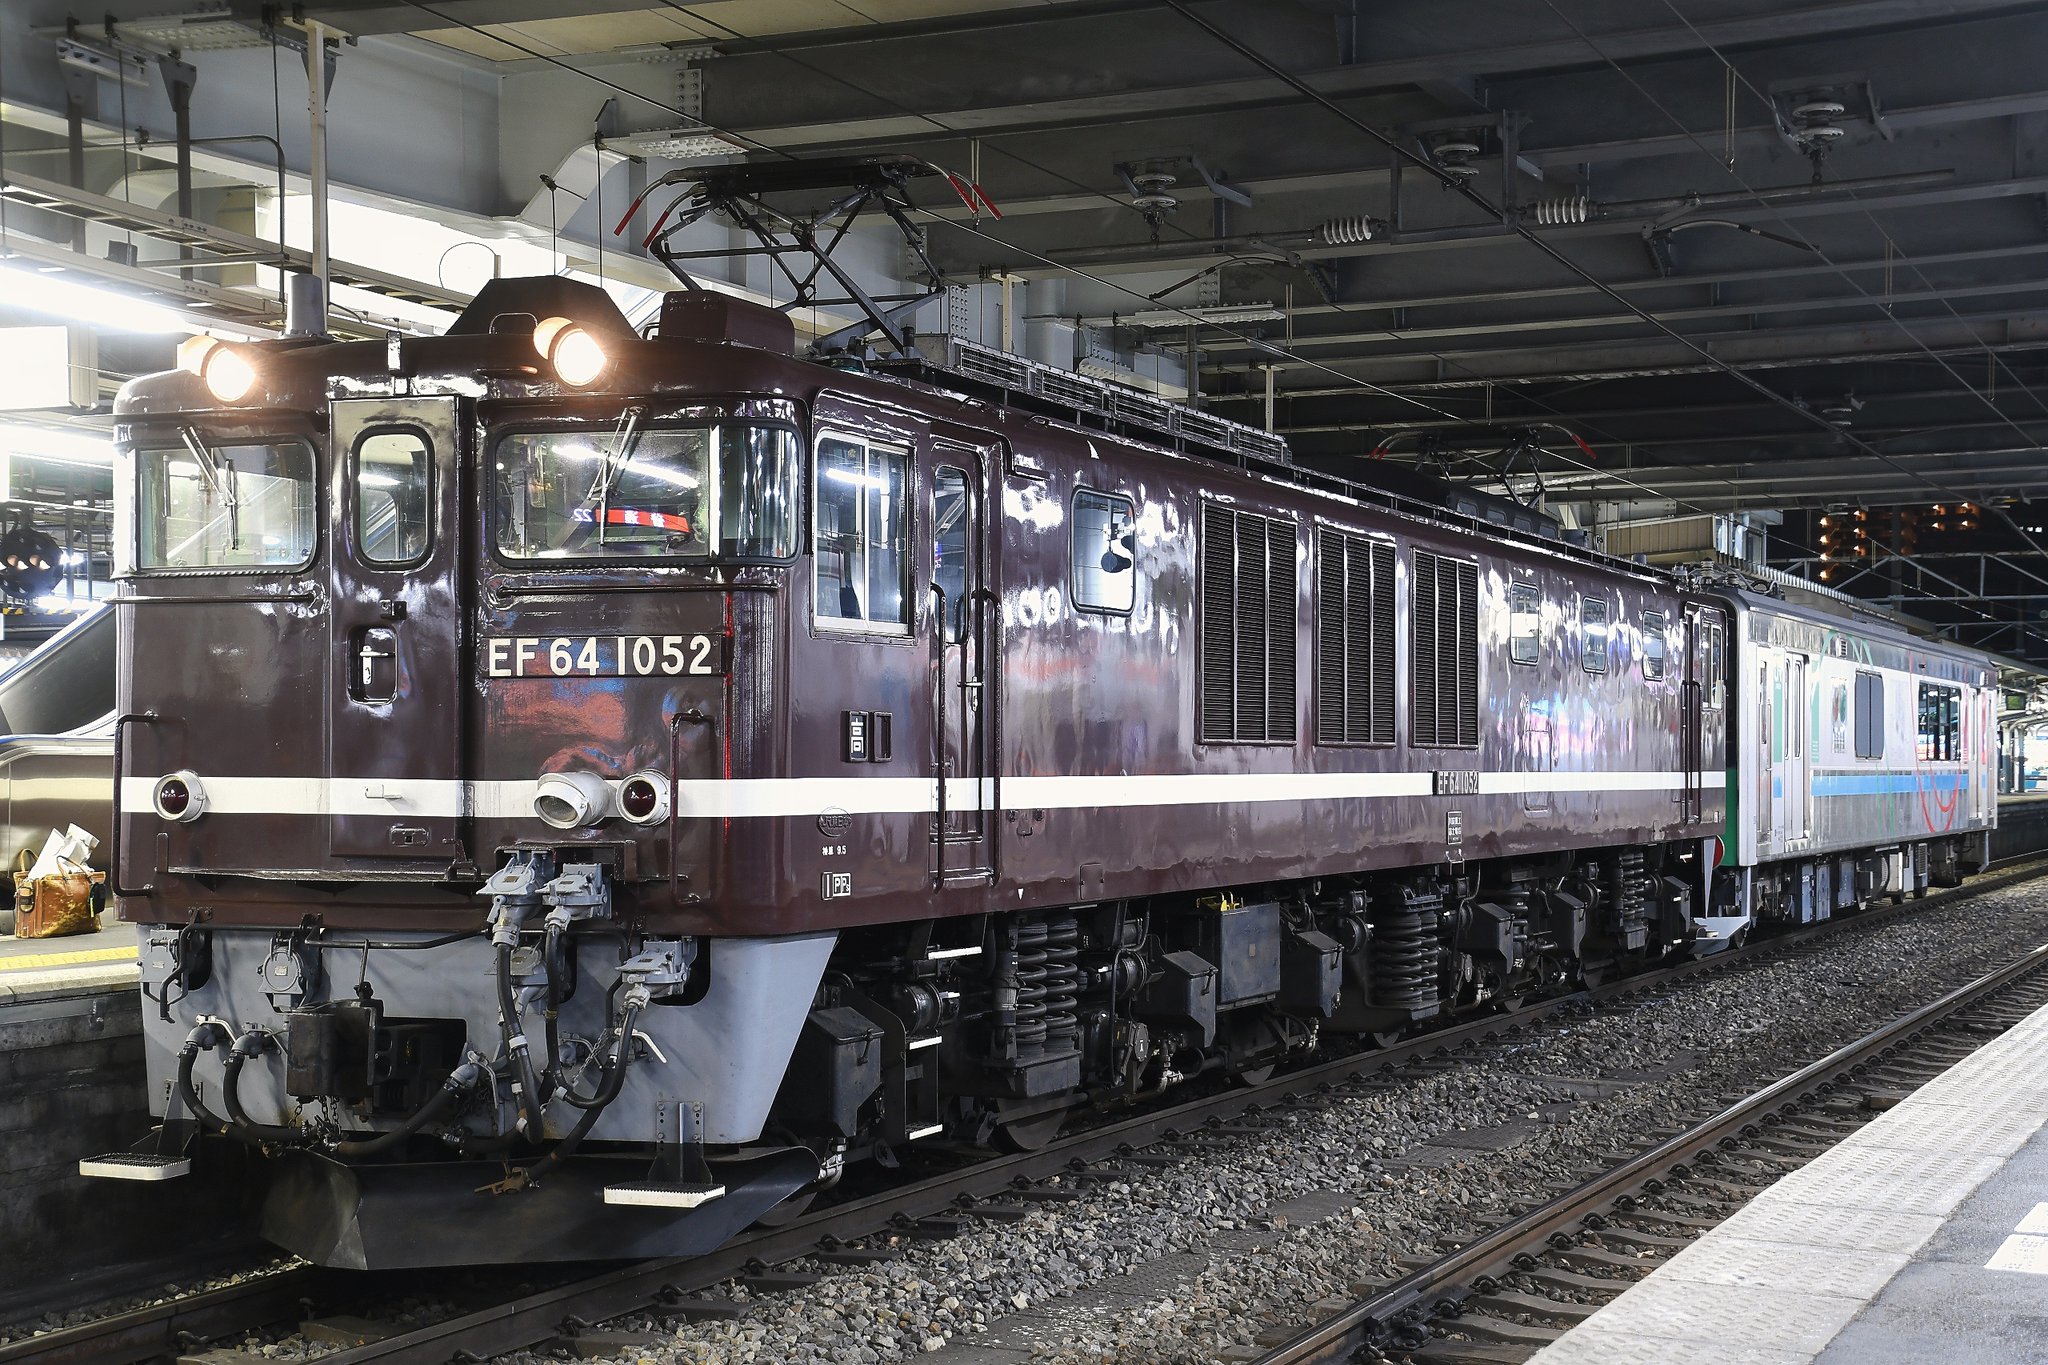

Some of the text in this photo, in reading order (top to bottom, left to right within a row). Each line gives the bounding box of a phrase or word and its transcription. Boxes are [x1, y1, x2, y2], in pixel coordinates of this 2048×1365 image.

[489, 635, 712, 677] EF 64 1052
[850, 717, 864, 754] 高
[1438, 770, 1478, 795] EF 64 1052
